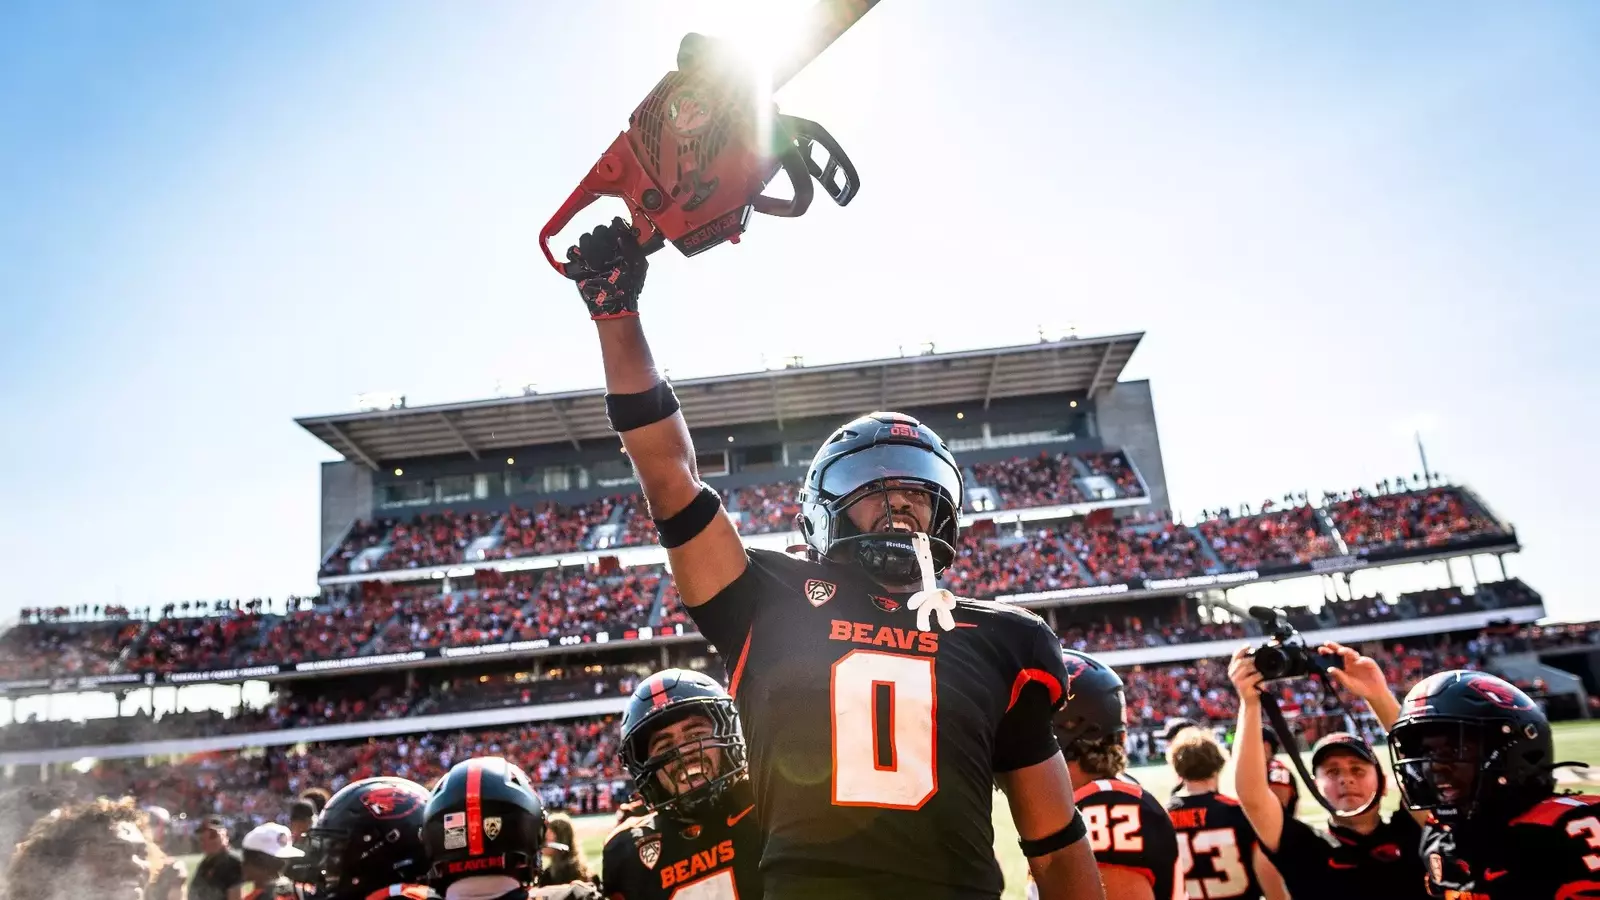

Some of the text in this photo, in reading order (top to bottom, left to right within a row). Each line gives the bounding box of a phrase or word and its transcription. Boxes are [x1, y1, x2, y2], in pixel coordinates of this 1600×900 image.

[889, 426, 919, 439] OSU
[807, 580, 835, 597] PAC
[810, 590, 826, 601] 12
[829, 619, 939, 653] BEAVS
[830, 649, 939, 811] 0
[1082, 804, 1144, 852] 82
[660, 839, 735, 889] BEAVS
